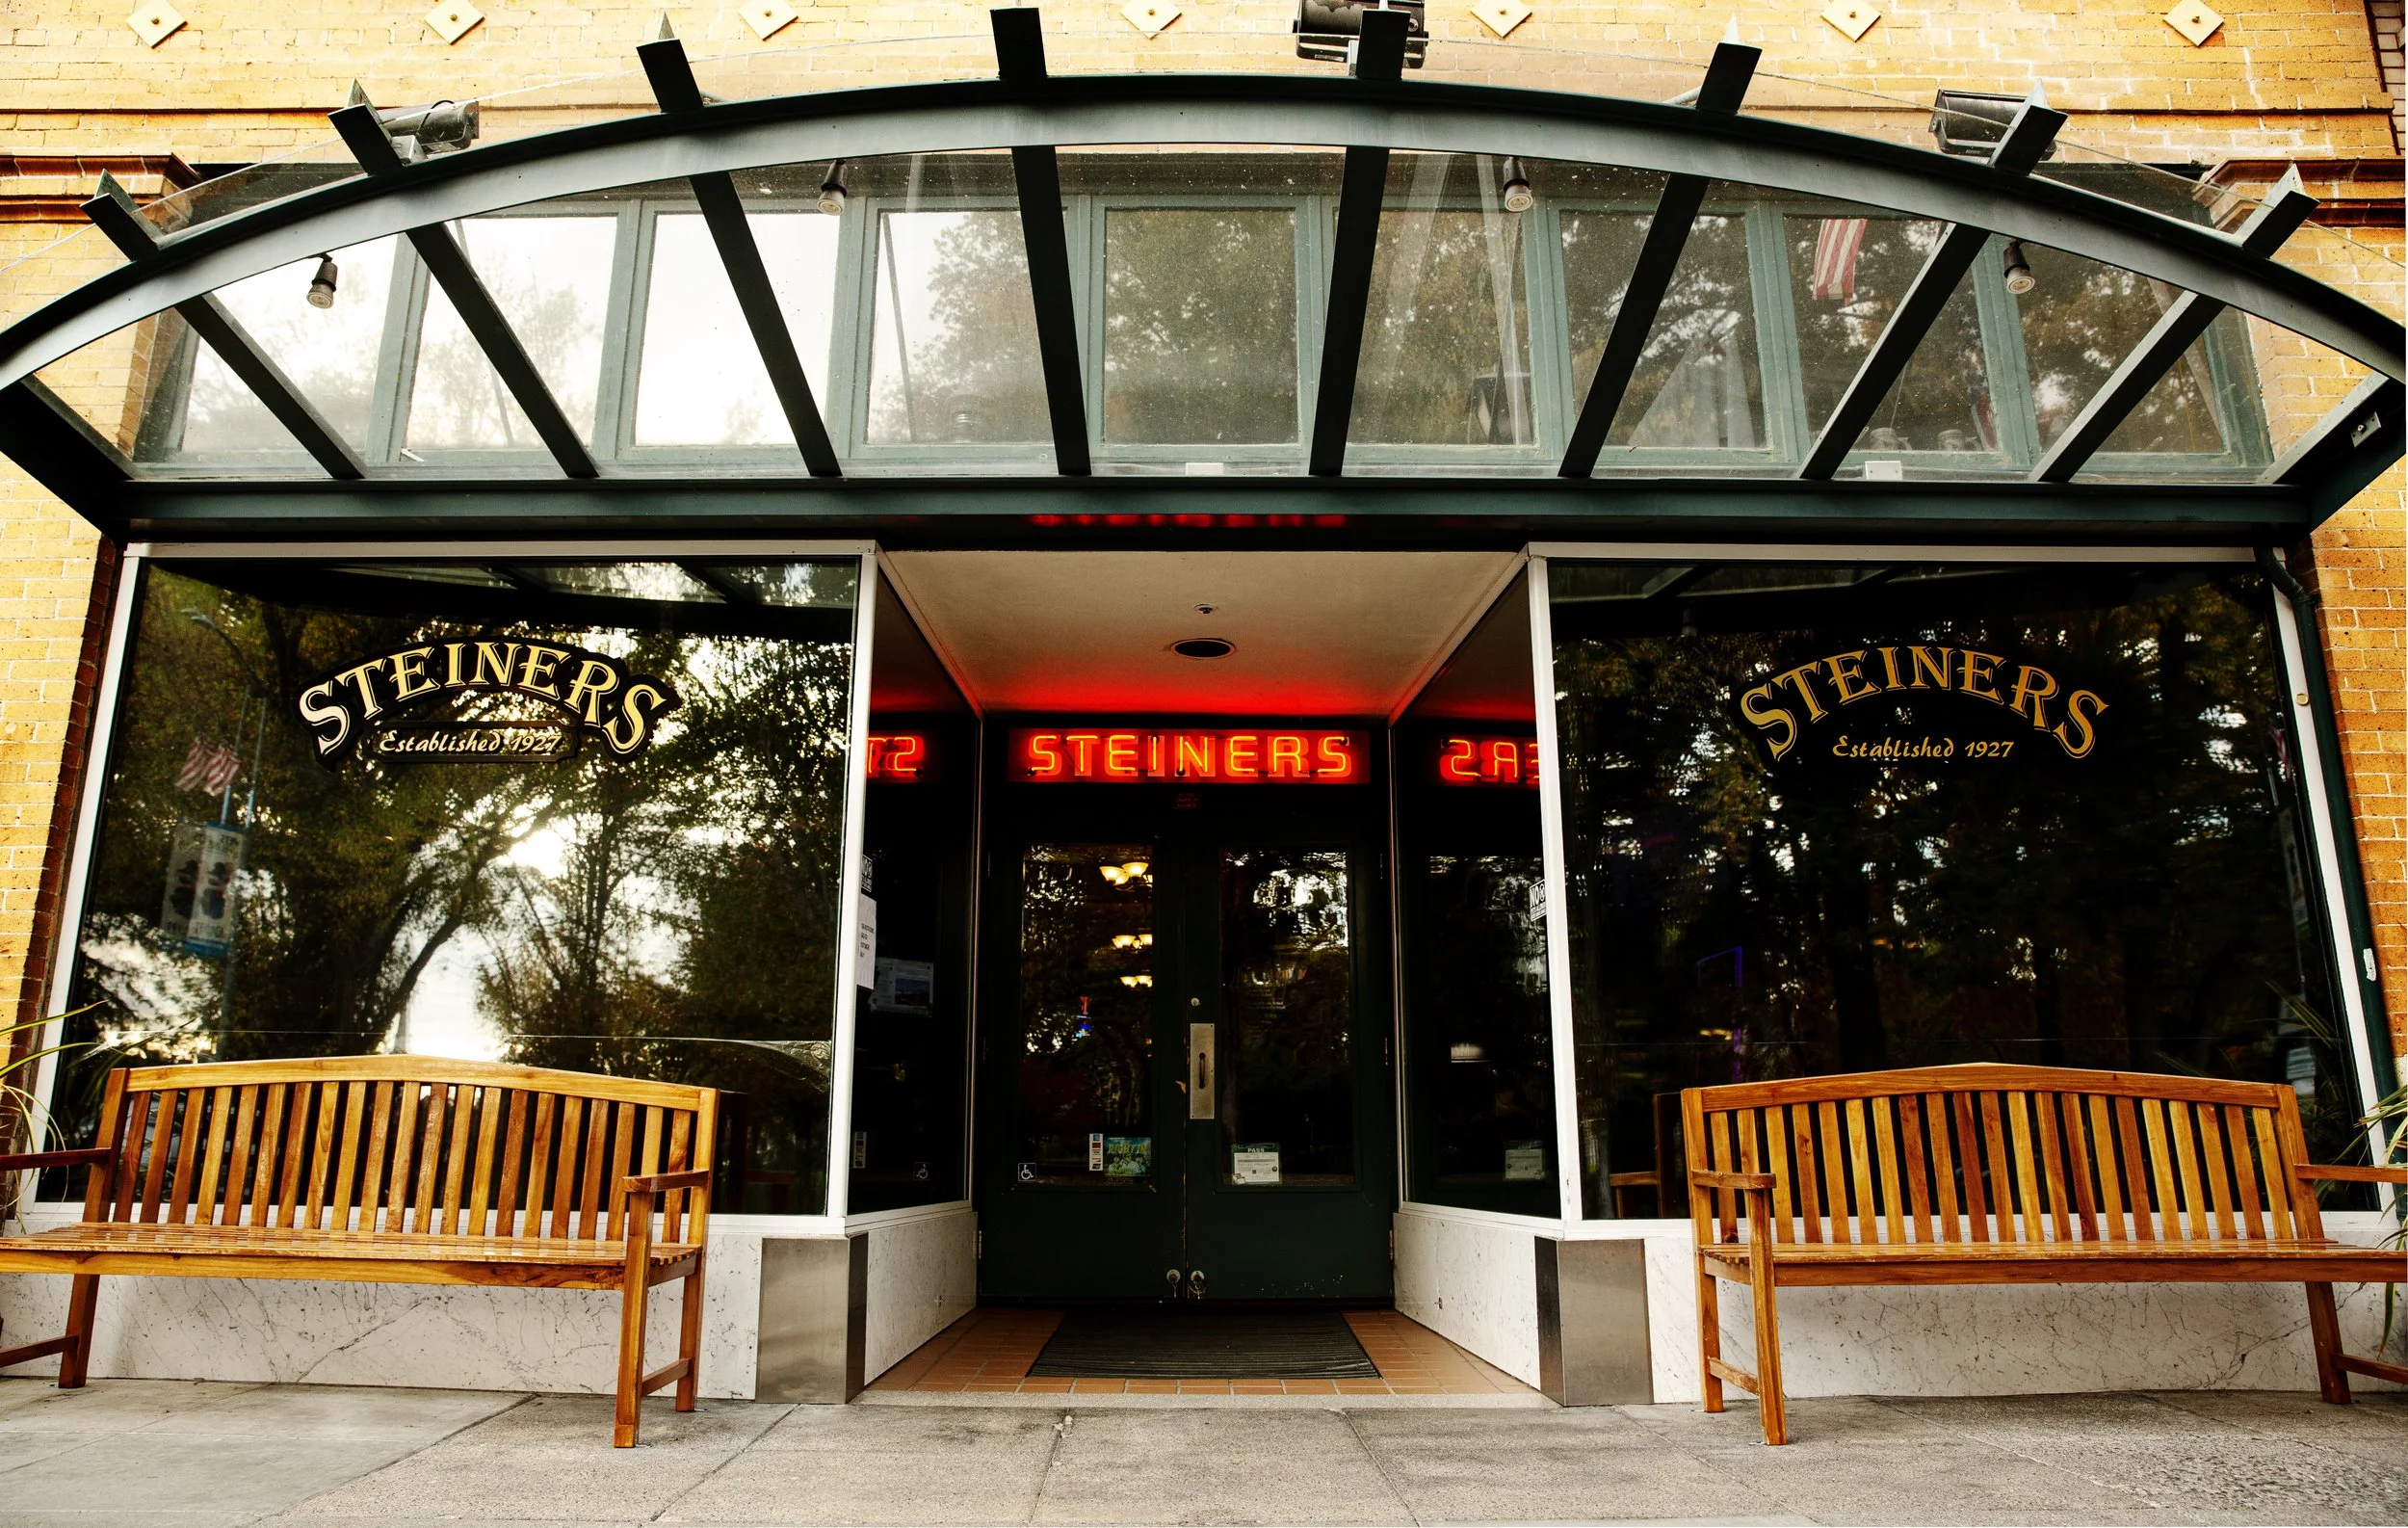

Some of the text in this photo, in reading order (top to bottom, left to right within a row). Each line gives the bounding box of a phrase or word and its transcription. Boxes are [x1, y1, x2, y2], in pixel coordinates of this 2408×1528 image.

[300, 642, 667, 754] STEINERS
[1741, 645, 2110, 762] STEINERS
[379, 730, 563, 753] Established 1927
[1028, 734, 1352, 777] STEINERS
[1832, 735, 2015, 758] Established 1927
